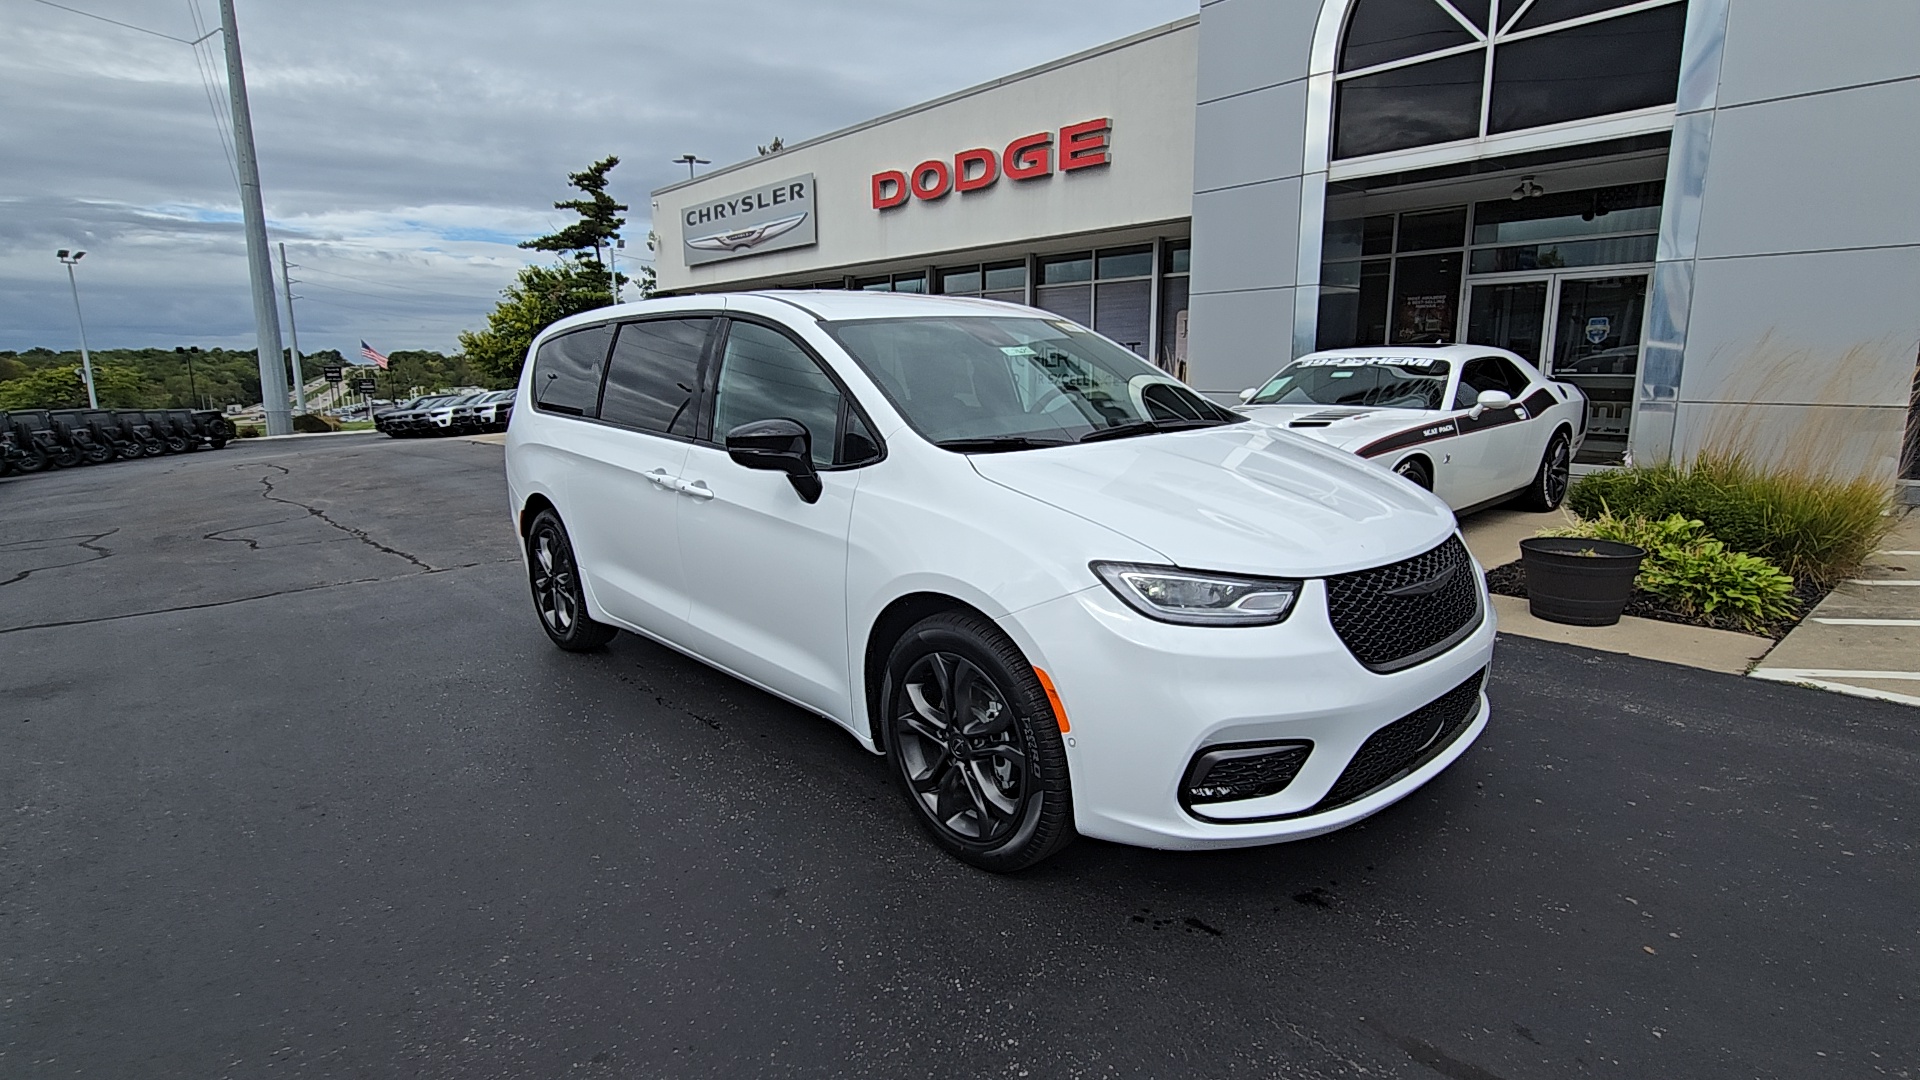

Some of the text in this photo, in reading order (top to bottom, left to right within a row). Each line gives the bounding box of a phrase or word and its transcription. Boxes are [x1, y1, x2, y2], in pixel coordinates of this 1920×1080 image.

[872, 116, 1113, 210] DODGE
[686, 182, 805, 226] CHRYSLER
[1369, 356, 1434, 367] HEMI
[1423, 428, 1438, 436] SCAT
